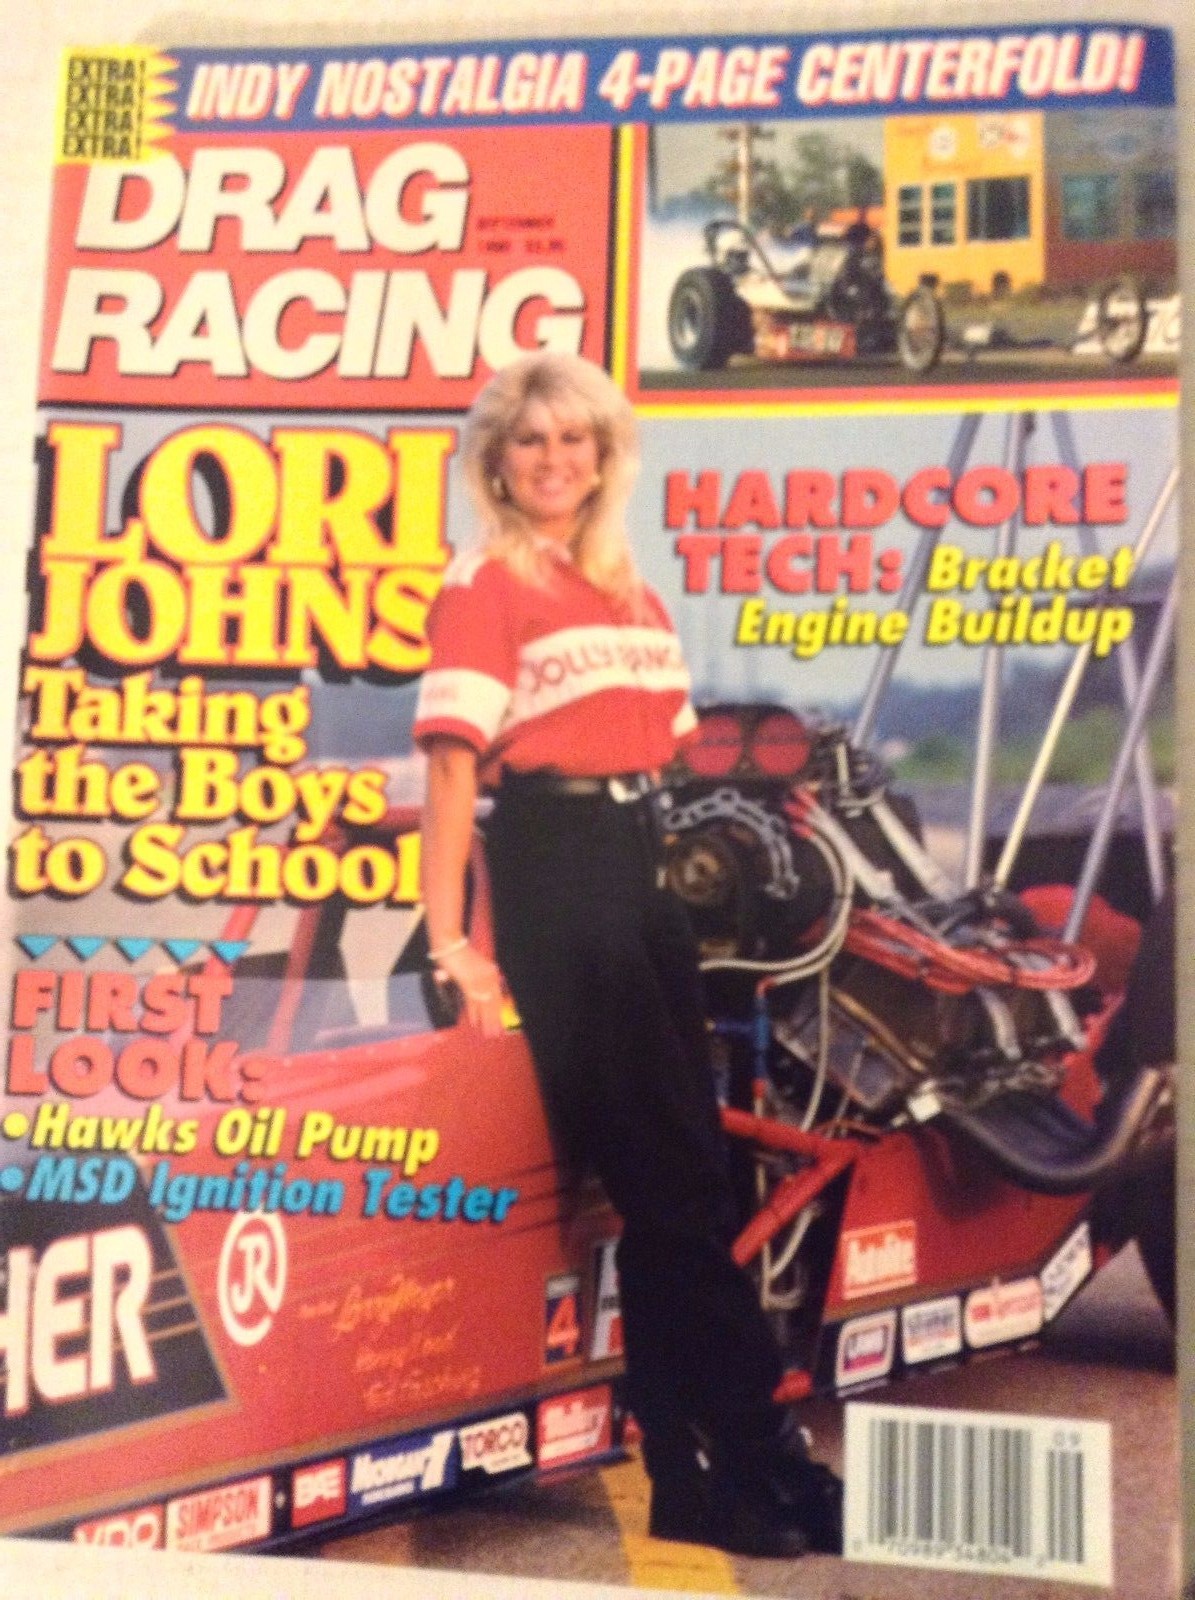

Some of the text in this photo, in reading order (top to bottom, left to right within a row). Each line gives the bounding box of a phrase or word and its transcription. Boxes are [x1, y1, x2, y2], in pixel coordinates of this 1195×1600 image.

[66, 83, 145, 107] EXTRA!
[68, 57, 146, 82] EXTRA!
[185, 32, 1146, 120] INDY NOSTALGIA 4-PAGE CENTERFOLD!
[62, 134, 141, 159] EXTRA!
[64, 108, 143, 133] EXTRA!
[75, 142, 470, 254] DRAG
[51, 266, 586, 380] RACING
[41, 420, 459, 566] LORI
[665, 464, 1129, 529] HARDCORE
[676, 533, 1135, 594] TECH: Bracket
[28, 560, 445, 671] JOHNS
[736, 595, 1134, 658] Engine Buildup
[24, 667, 311, 764] Taking
[17, 744, 388, 842] the Boys
[12, 824, 422, 903] to School
[13, 970, 234, 1035] FIRST
[31, 1104, 439, 1175] Hawks Oil Pump
[27, 1157, 518, 1224] MSD Ignition Tester
